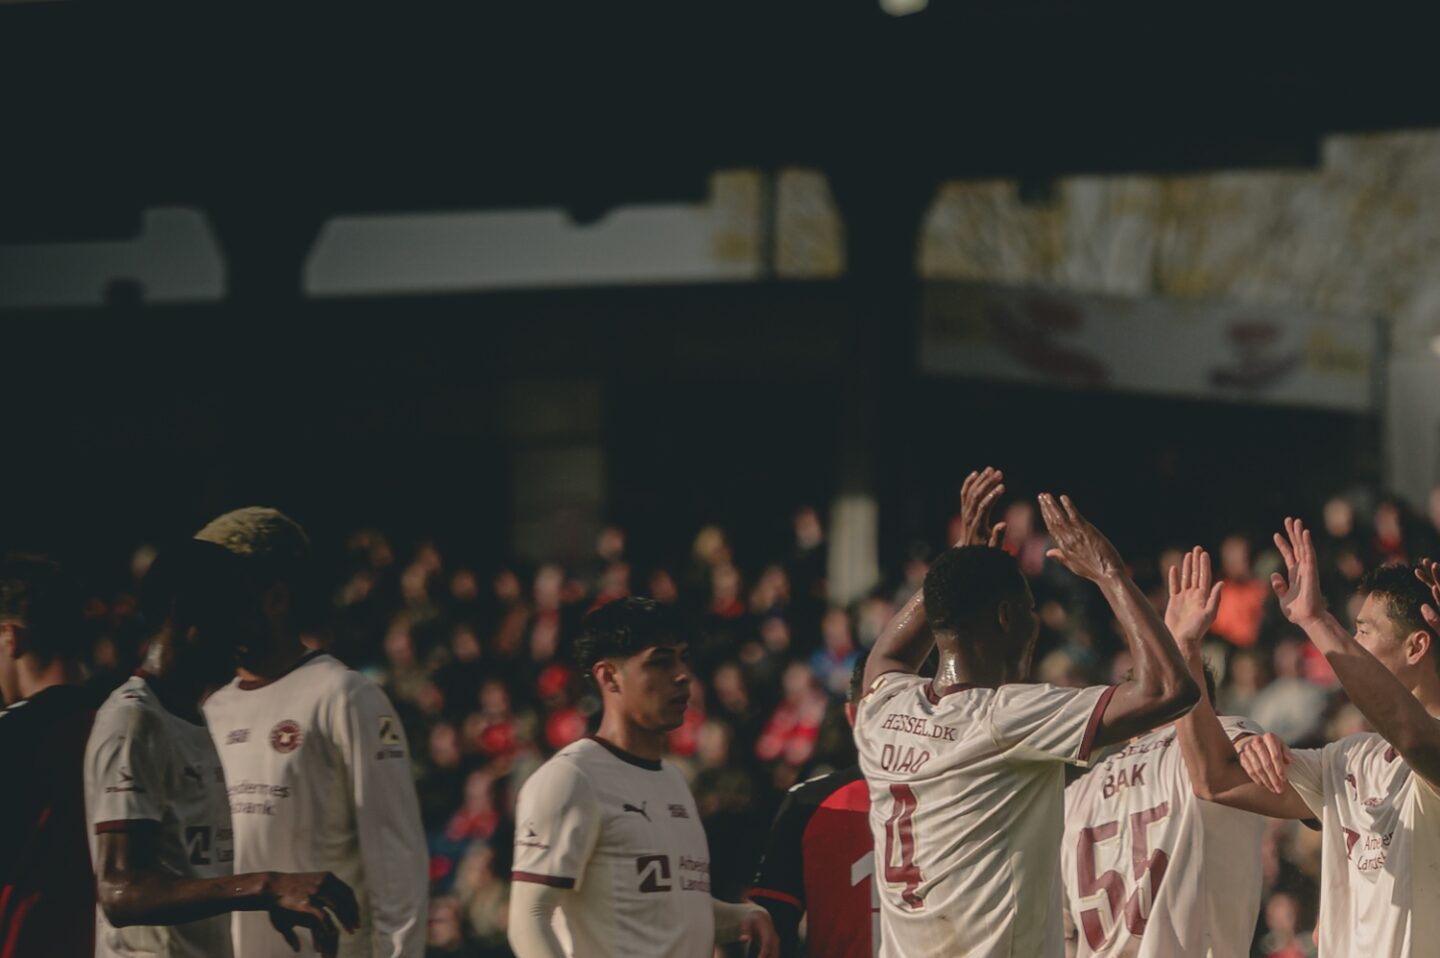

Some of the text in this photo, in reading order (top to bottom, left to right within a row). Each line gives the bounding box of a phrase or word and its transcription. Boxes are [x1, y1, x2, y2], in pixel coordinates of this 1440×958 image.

[1103, 762, 1148, 799] BAK
[885, 783, 925, 910] 4
[1077, 801, 1170, 952] 55
